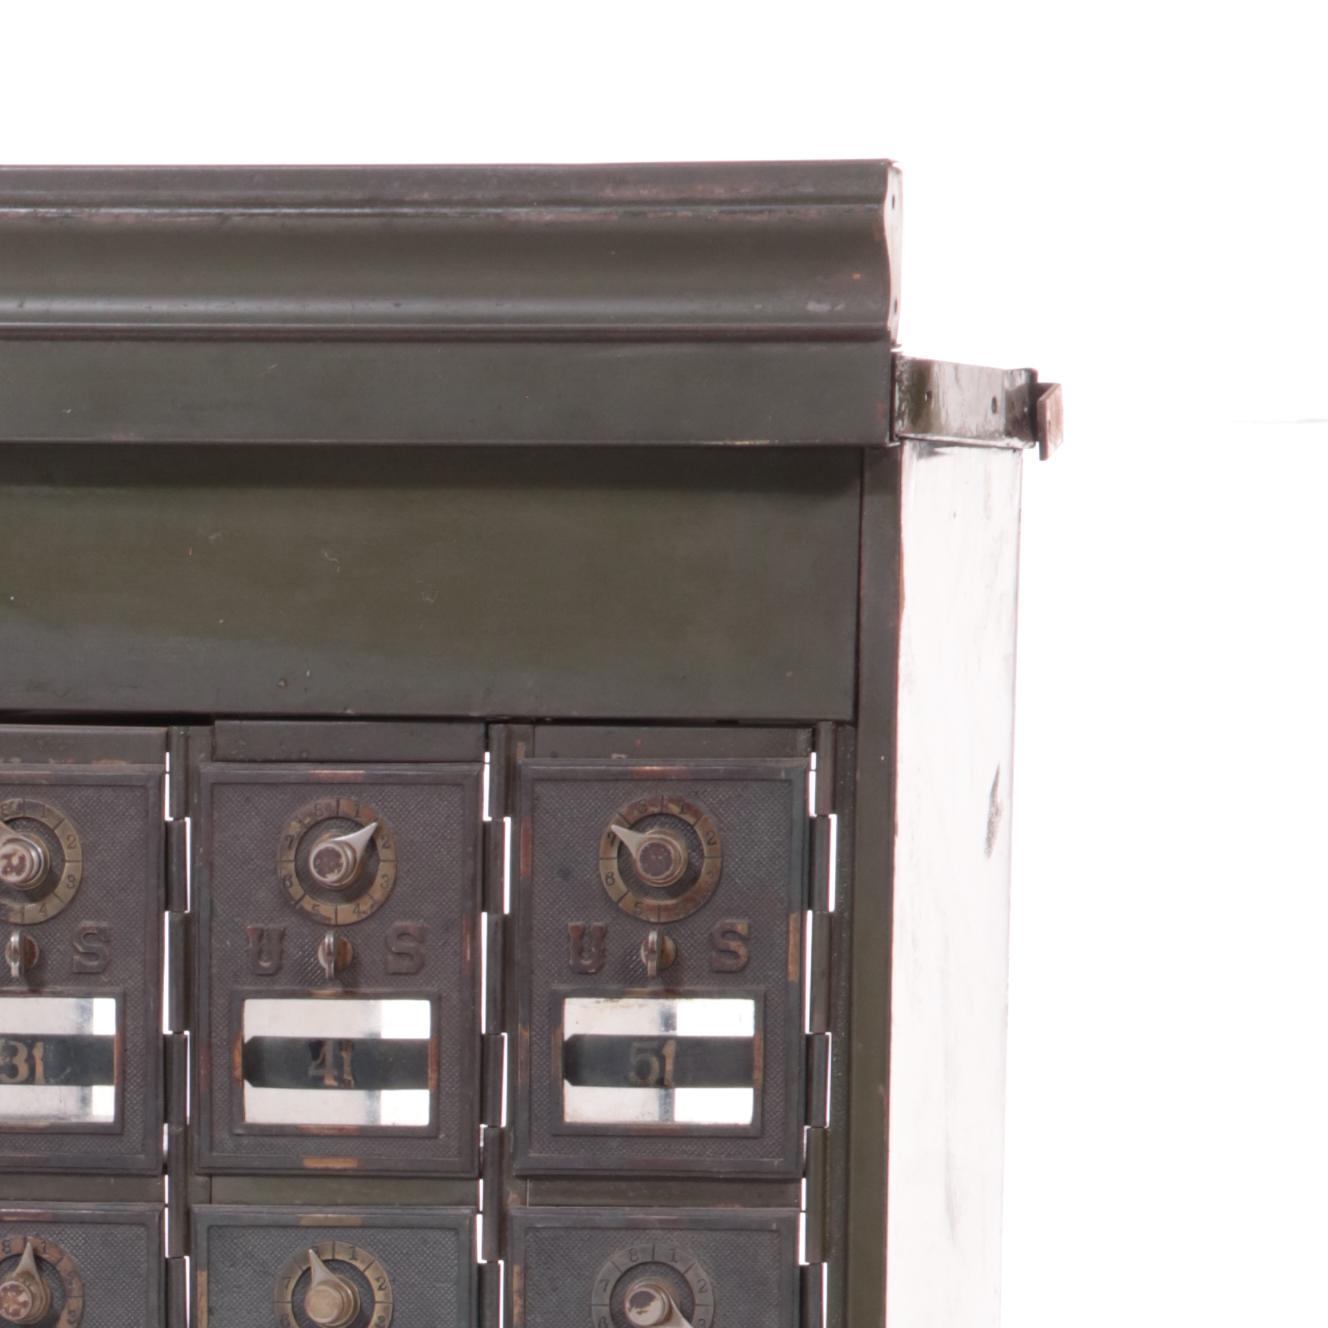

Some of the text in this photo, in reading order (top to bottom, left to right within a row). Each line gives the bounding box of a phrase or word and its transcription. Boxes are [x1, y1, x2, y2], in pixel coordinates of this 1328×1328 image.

[72, 921, 112, 973] S
[246, 921, 428, 977] U S
[567, 921, 750, 973] U S
[308, 1040, 355, 1087] 41
[629, 1040, 676, 1088] 51
